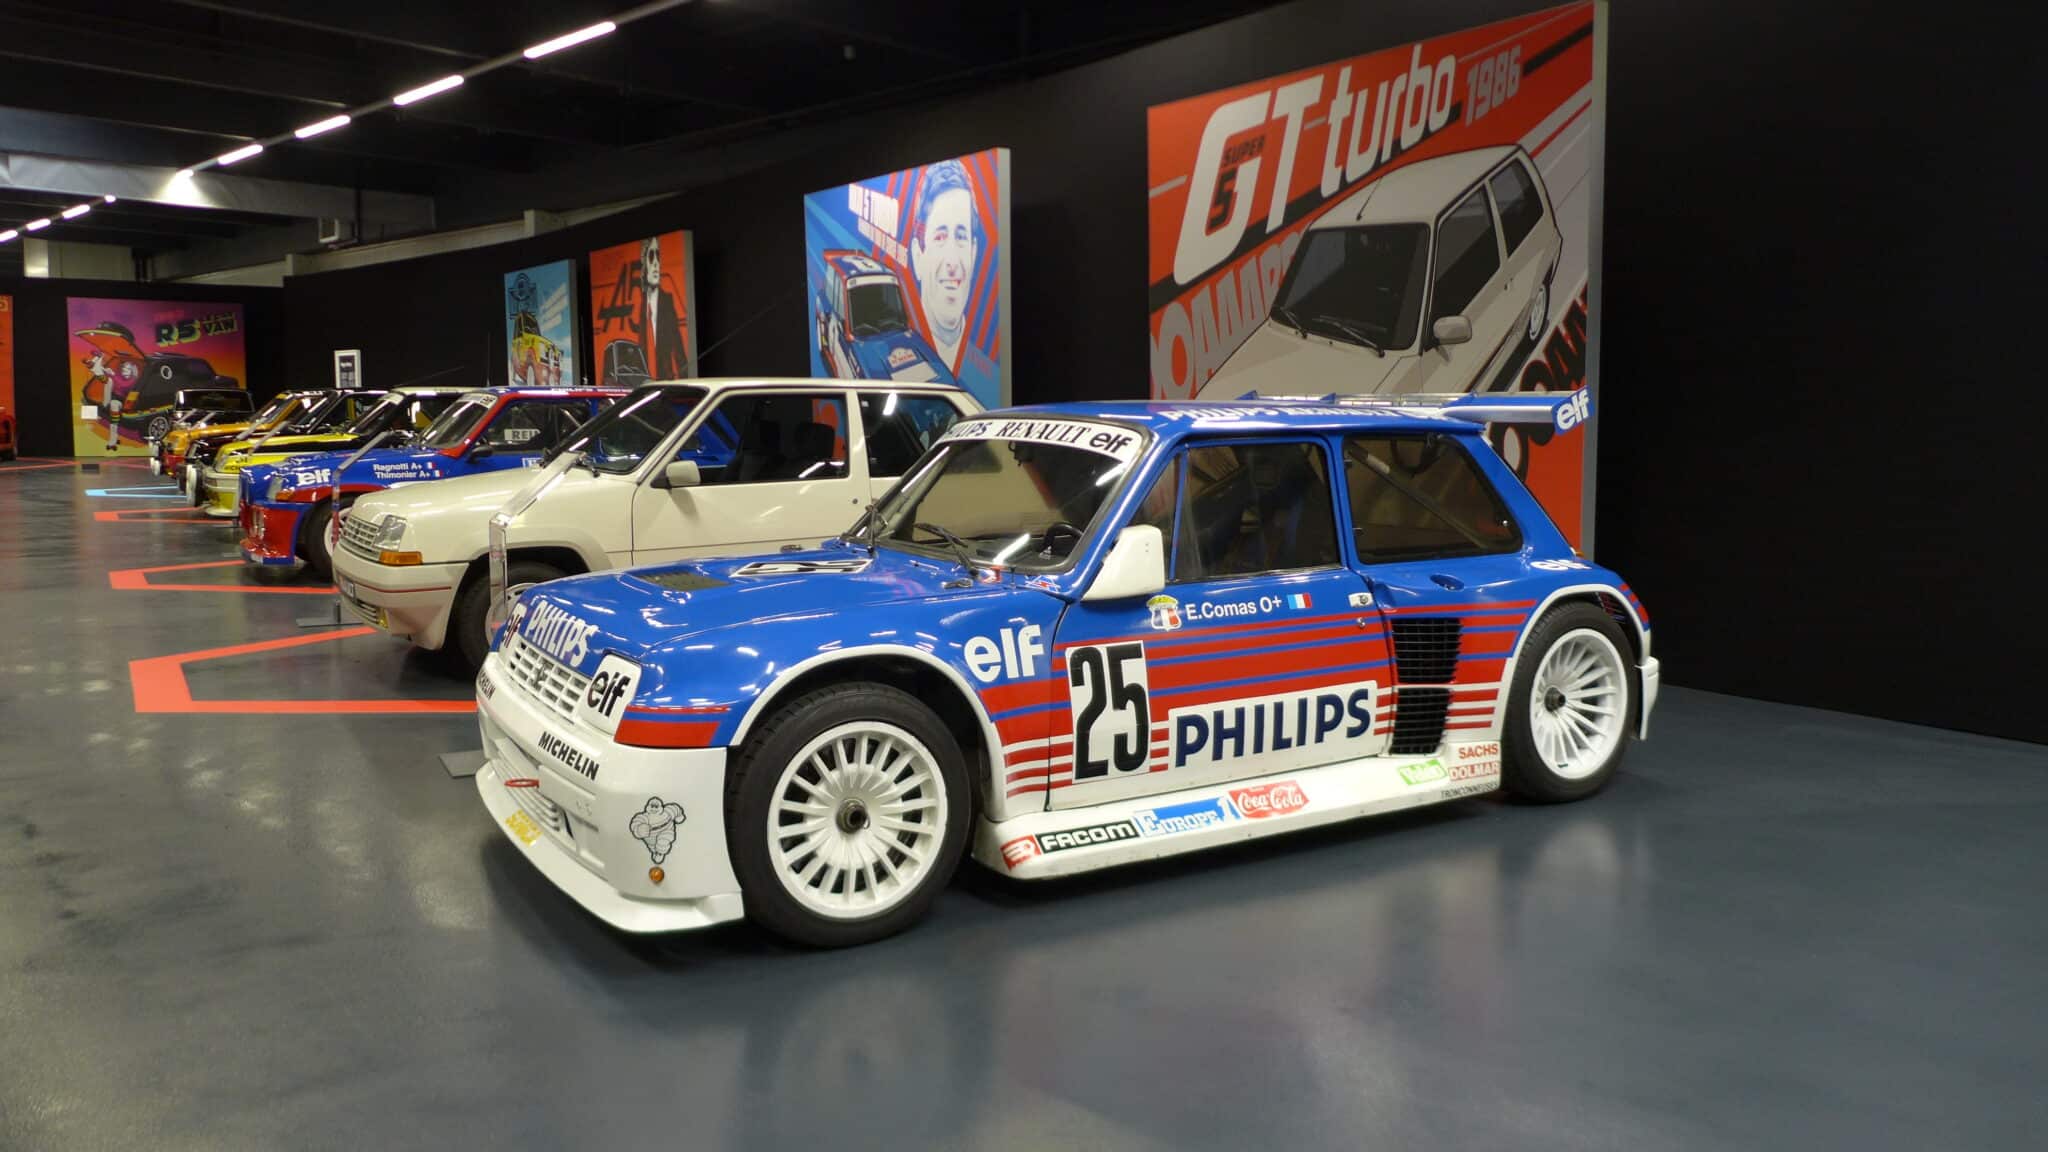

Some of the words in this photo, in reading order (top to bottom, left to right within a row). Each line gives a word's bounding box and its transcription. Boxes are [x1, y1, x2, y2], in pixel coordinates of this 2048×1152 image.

[1173, 73, 1323, 286] GT
[1320, 43, 1456, 199] turbo
[1465, 46, 1522, 127] 1986
[1222, 135, 1266, 168] SUPER
[1557, 390, 1590, 431] elf
[996, 421, 1090, 444] RENAULT
[1089, 431, 1132, 454] elf
[298, 468, 331, 486] elf
[1185, 600, 1257, 621] E.Comas
[1259, 595, 1283, 614] O+
[523, 599, 599, 668] PHILIPS
[964, 624, 1044, 683] elf
[587, 670, 631, 718] elf
[1070, 642, 1148, 781] 25
[1175, 688, 1372, 768] PHILIPS
[538, 731, 600, 781] MICHELIN
[1458, 743, 1499, 759] SACHS
[1449, 762, 1499, 780] DOLMAR
[1237, 782, 1307, 814] Coca-Cola
[1042, 821, 1136, 851] FACOM
